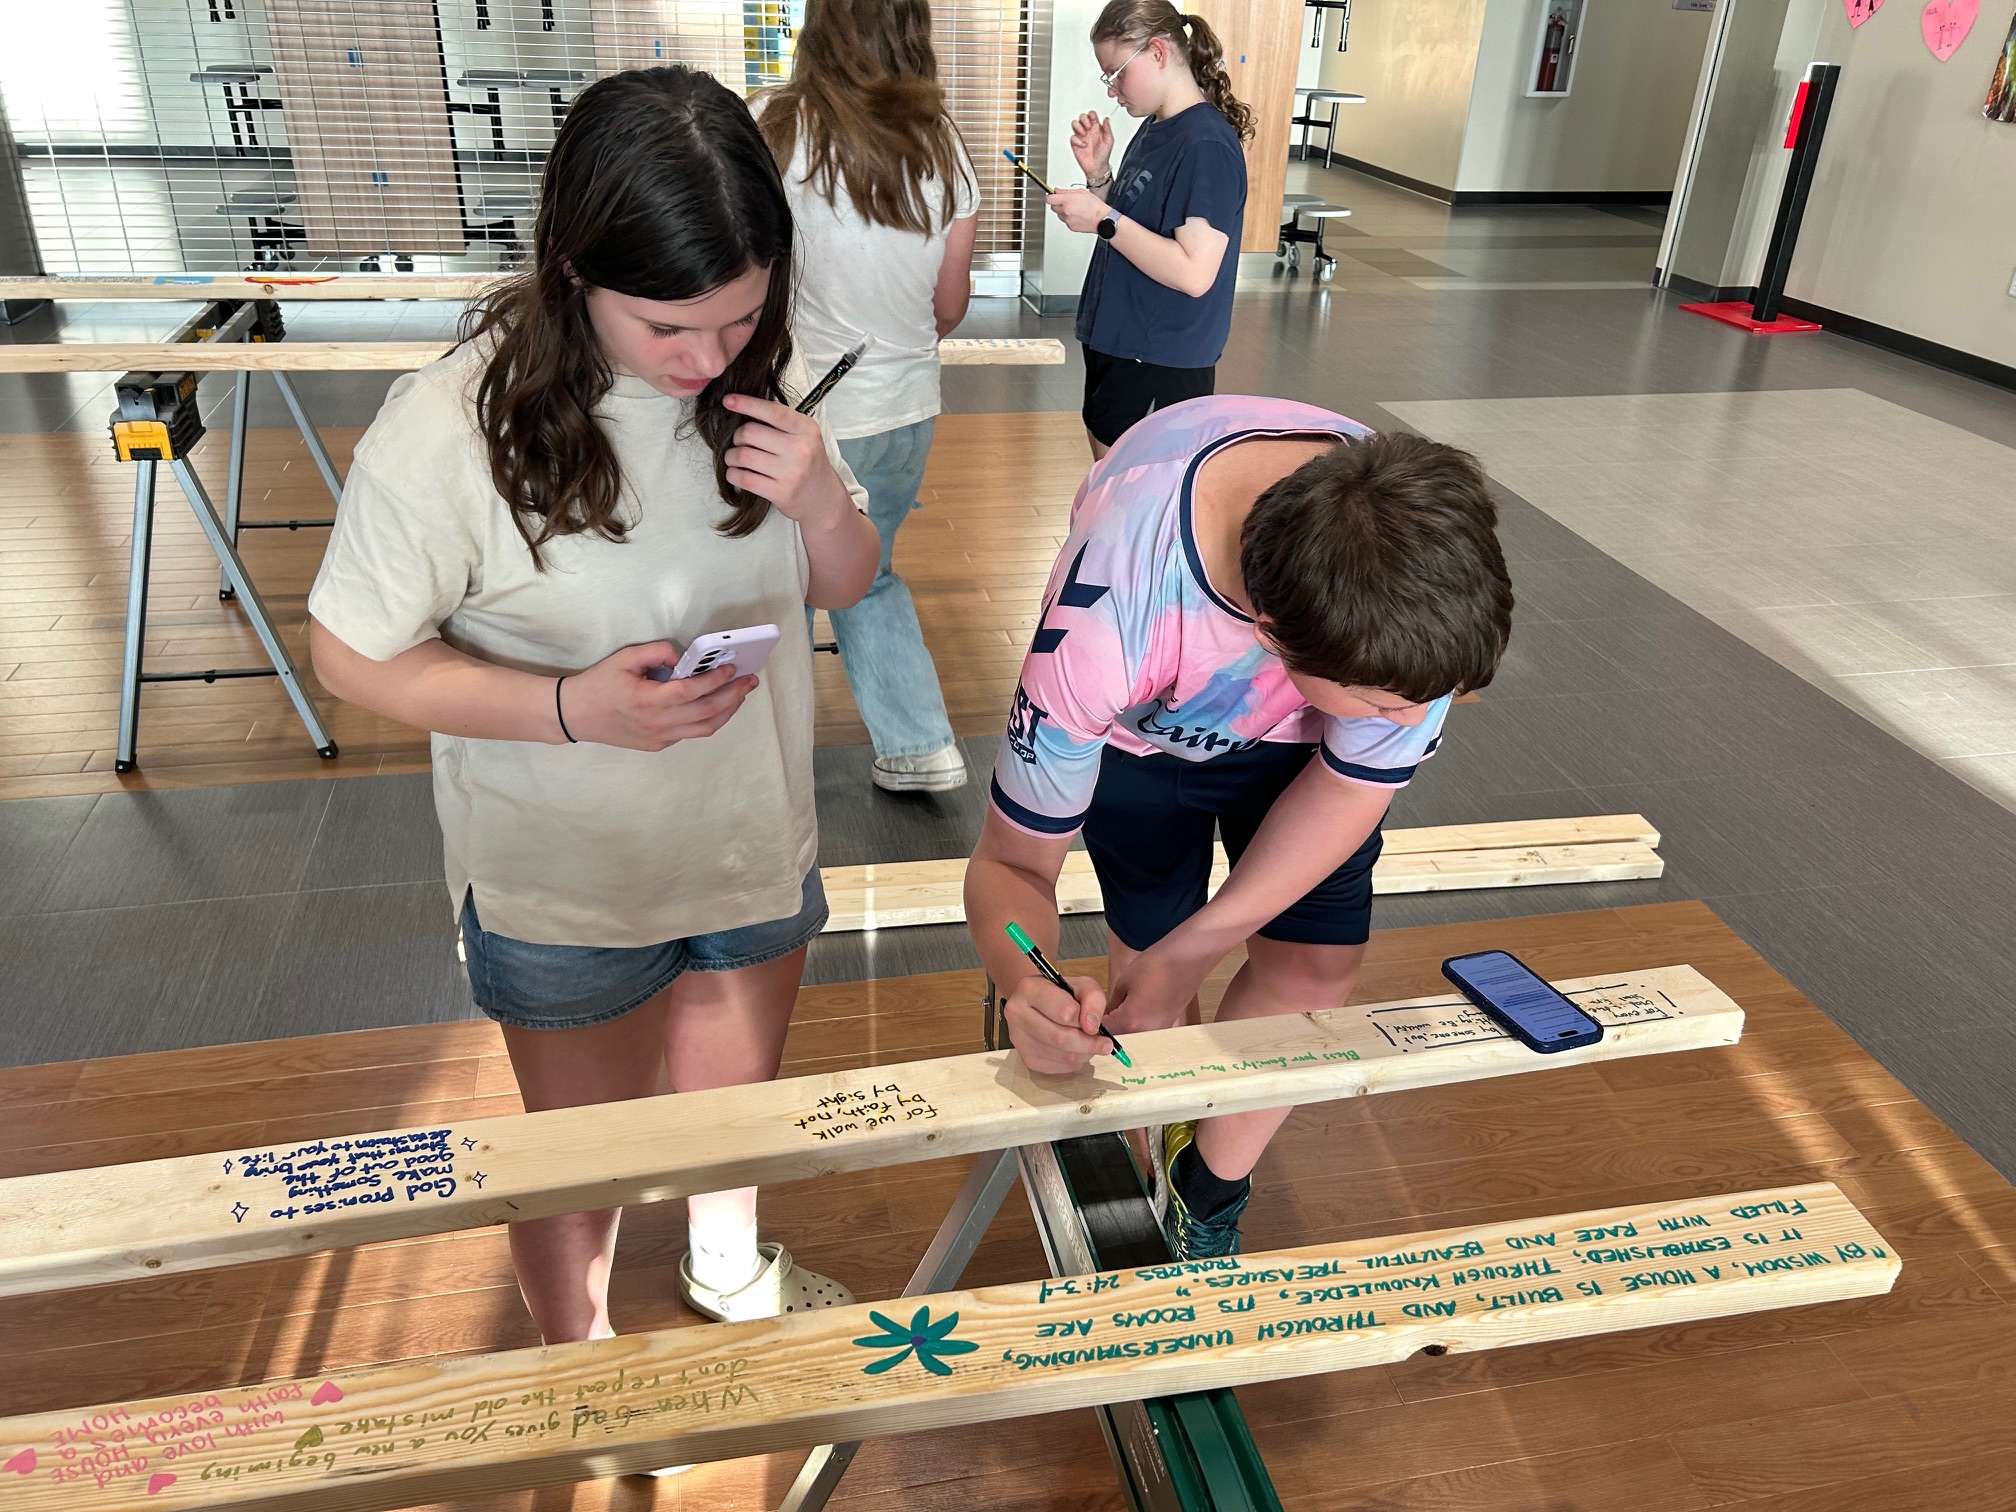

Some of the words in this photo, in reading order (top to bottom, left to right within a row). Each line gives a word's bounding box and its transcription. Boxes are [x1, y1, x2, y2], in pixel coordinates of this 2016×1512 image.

[1323, 1049, 1361, 1062] Bless
[816, 1090, 866, 1108] sight
[873, 1083, 901, 1098] by
[897, 1093, 927, 1107] by
[794, 1111, 834, 1130] not
[865, 1113, 896, 1128] we
[812, 1121, 859, 1140] walk
[281, 1140, 325, 1160] your
[331, 1141, 353, 1152] to
[237, 1151, 275, 1165] life
[404, 1151, 455, 1169] good
[243, 1161, 293, 1177] bring
[326, 1165, 356, 1183] of
[360, 1161, 402, 1175] out
[392, 1163, 454, 1182] make
[282, 1171, 321, 1186] the
[407, 1177, 457, 1201] God
[303, 1186, 395, 1215] promises
[1729, 1198, 1809, 1220] FILLED
[270, 1206, 299, 1219] to
[1657, 1213, 1711, 1231] WITH
[1505, 1232, 1557, 1251] AND
[1573, 1221, 1639, 1243] RARE
[1742, 1231, 1770, 1246] IS
[1779, 1227, 1804, 1243] IT
[1357, 1240, 1486, 1270] BEAUTIFUL
[1730, 1250, 1832, 1277] WISDOM,
[1135, 1257, 1241, 1282] PROVERBS
[1452, 1257, 1562, 1286] THROUGH
[1700, 1264, 1721, 1281] A
[1279, 1273, 1440, 1305] KNOWLEDGE,
[1576, 1279, 1603, 1297] IS
[1619, 1268, 1697, 1292] HOUSE
[1217, 1294, 1256, 1313] ITS
[1401, 1299, 1457, 1318] AND
[1475, 1286, 1564, 1312] BUILT,
[1112, 1305, 1197, 1328] ROOMS
[1257, 1310, 1387, 1341] THROUGH
[1034, 1319, 1093, 1338] ARE
[1002, 1329, 1234, 1371] UNDERSTANDING,
[575, 1368, 661, 1400] repeat
[236, 1382, 304, 1414] faith
[521, 1387, 556, 1407] the
[656, 1383, 760, 1413] When
[470, 1397, 508, 1423] old
[48, 1406, 132, 1449] HOME
[89, 1394, 223, 1450] becomes
[144, 1410, 225, 1445] every
[224, 1410, 285, 1438] with
[505, 1410, 561, 1438] gives
[161, 1432, 218, 1460] love
[353, 1441, 396, 1456] new
[409, 1437, 426, 1450] a
[58, 1446, 78, 1461] a
[50, 1443, 131, 1486] HOUSE
[93, 1455, 149, 1489] and
